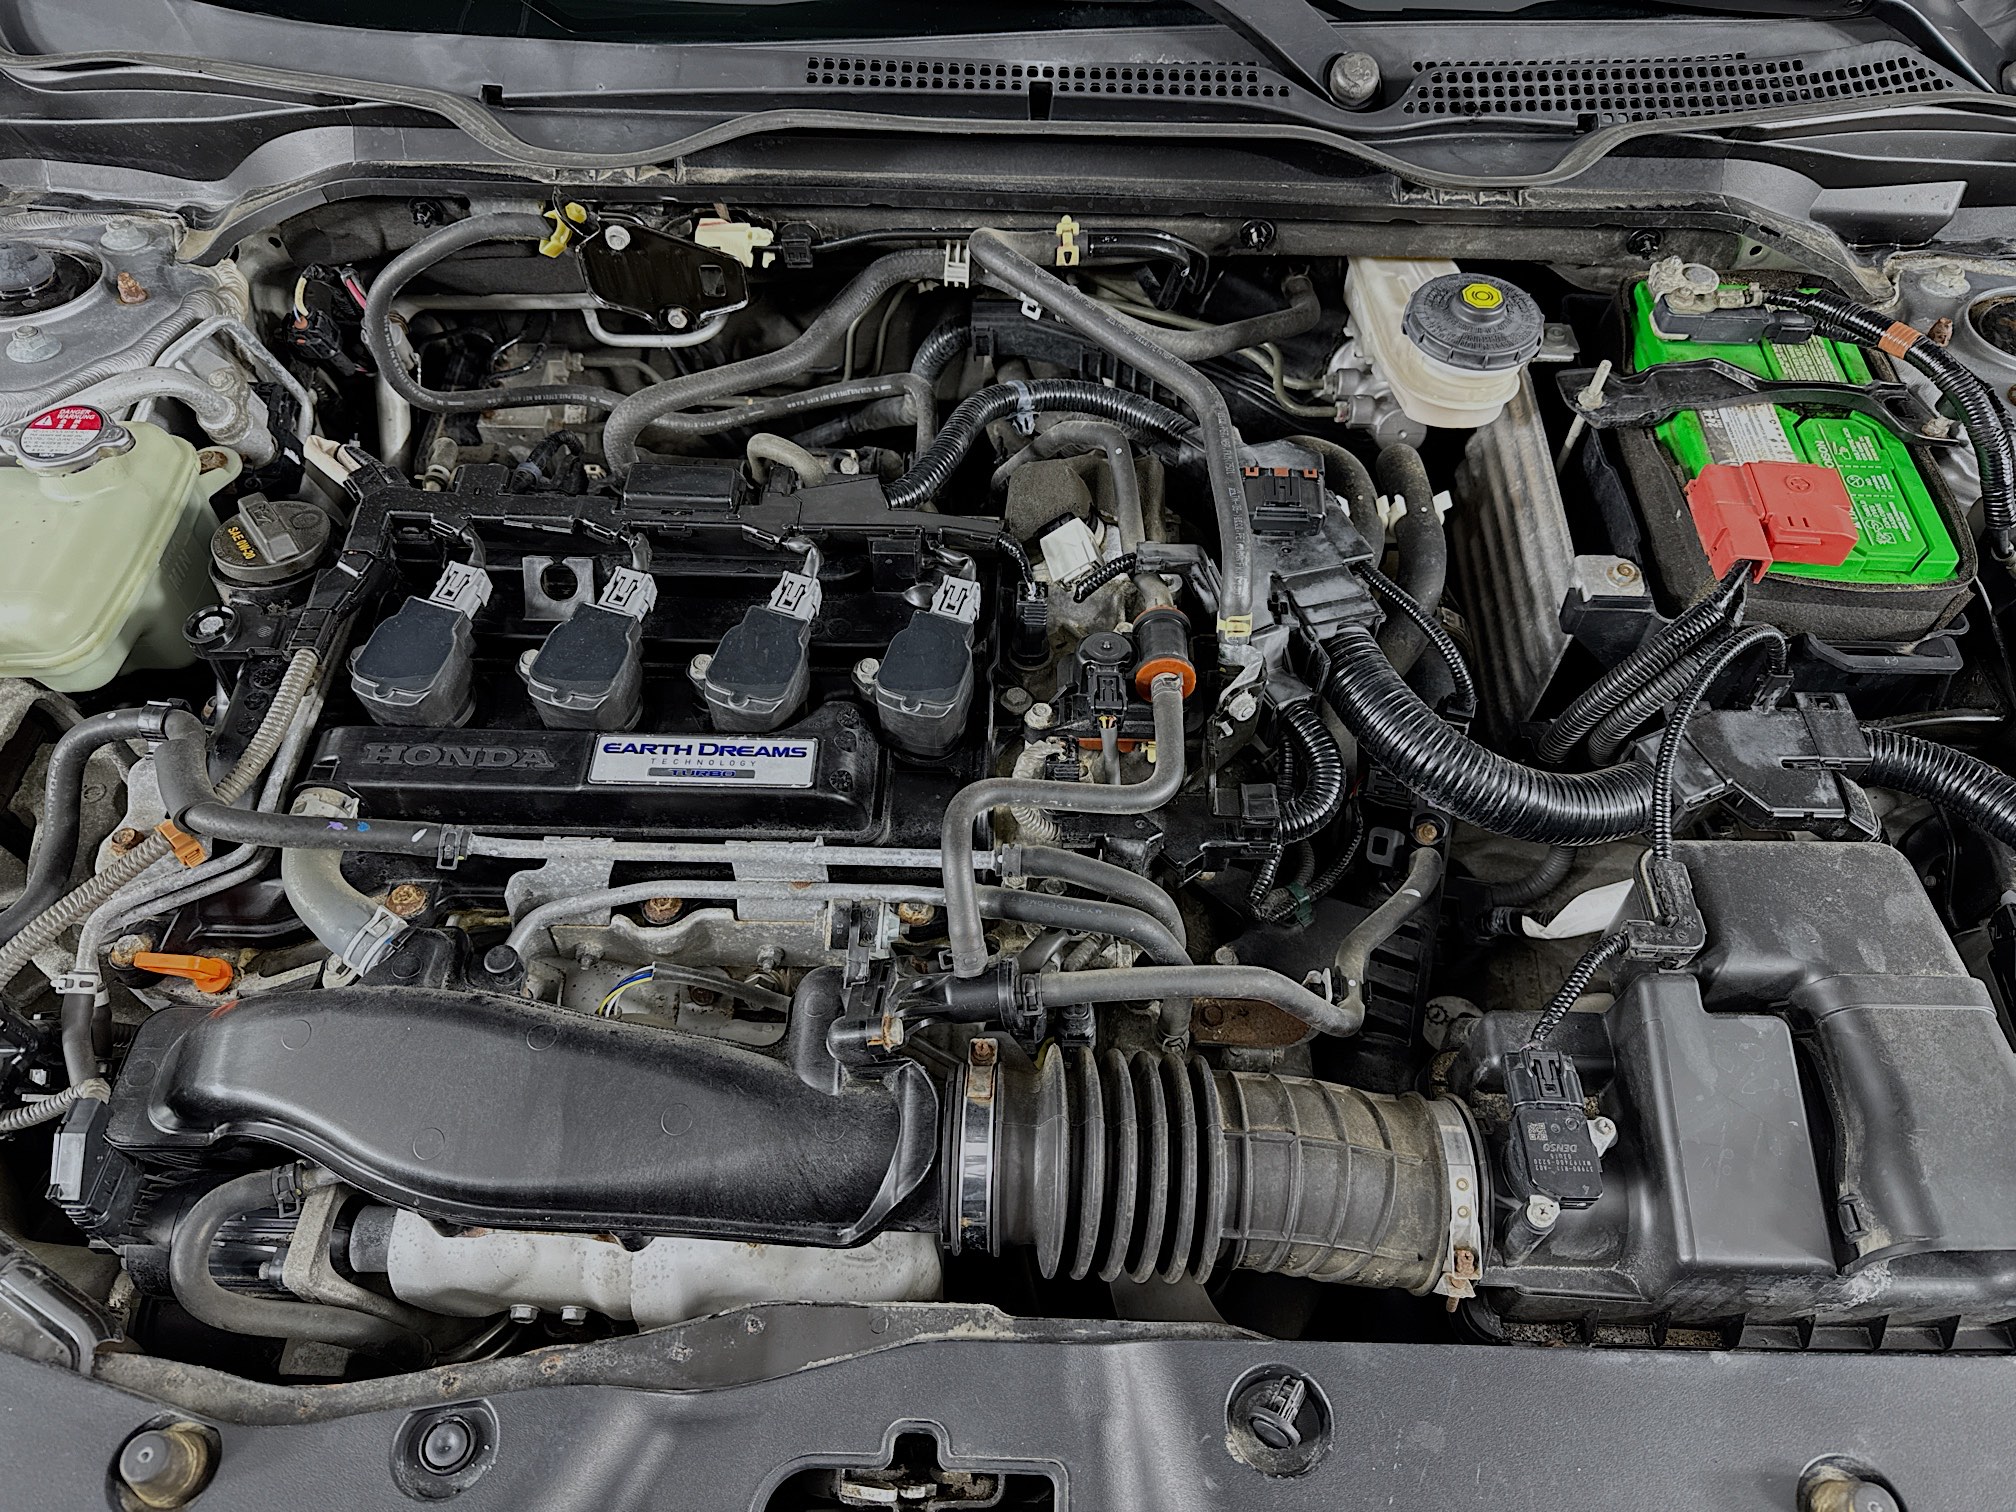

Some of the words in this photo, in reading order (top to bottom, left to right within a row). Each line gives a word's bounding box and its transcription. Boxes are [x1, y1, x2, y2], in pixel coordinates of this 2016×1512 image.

[1814, 440, 1835, 468] OISON
[227, 526, 240, 542] SAE
[235, 538, 256, 560] 0W-20
[361, 743, 557, 769] HONDA
[603, 742, 694, 755] EARTH
[698, 743, 808, 758] DREAMS
[650, 757, 757, 767] TECHNOLOGY
[668, 768, 737, 778] TURBO
[1542, 1143, 1578, 1153] DENSO
